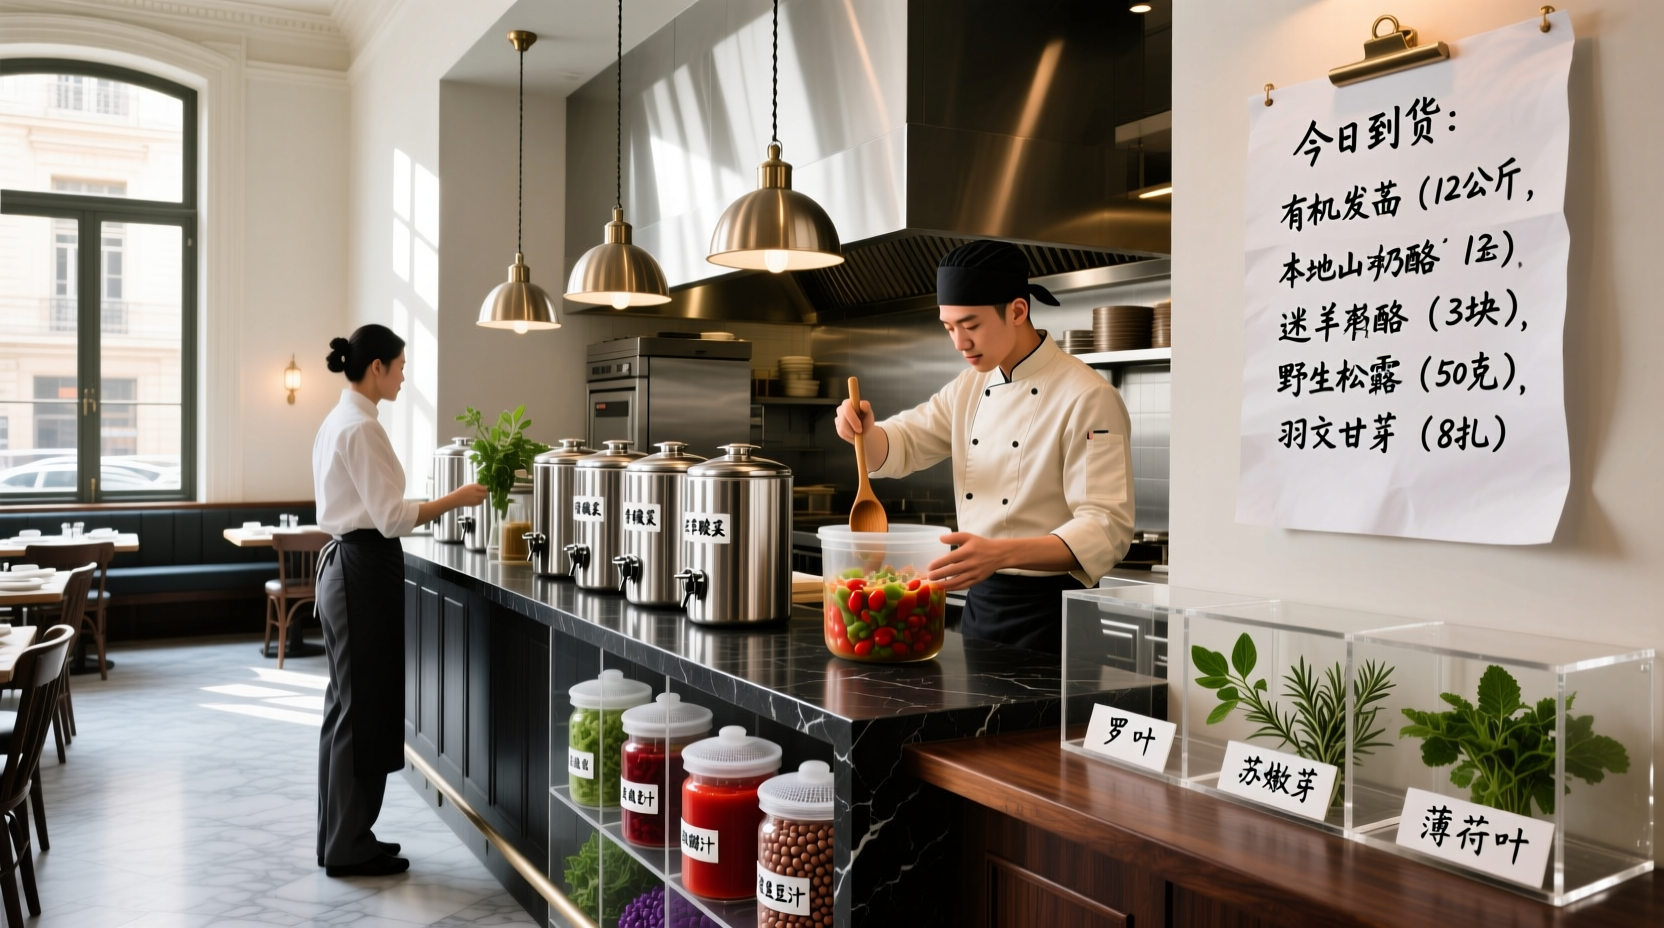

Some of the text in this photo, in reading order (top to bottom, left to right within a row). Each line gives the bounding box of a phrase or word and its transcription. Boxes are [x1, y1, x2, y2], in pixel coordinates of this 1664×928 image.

[1292, 96, 1456, 168] 今日到货：
[1103, 716, 1156, 757] 罗叶
[1420, 805, 1530, 866] 薄荷叶
